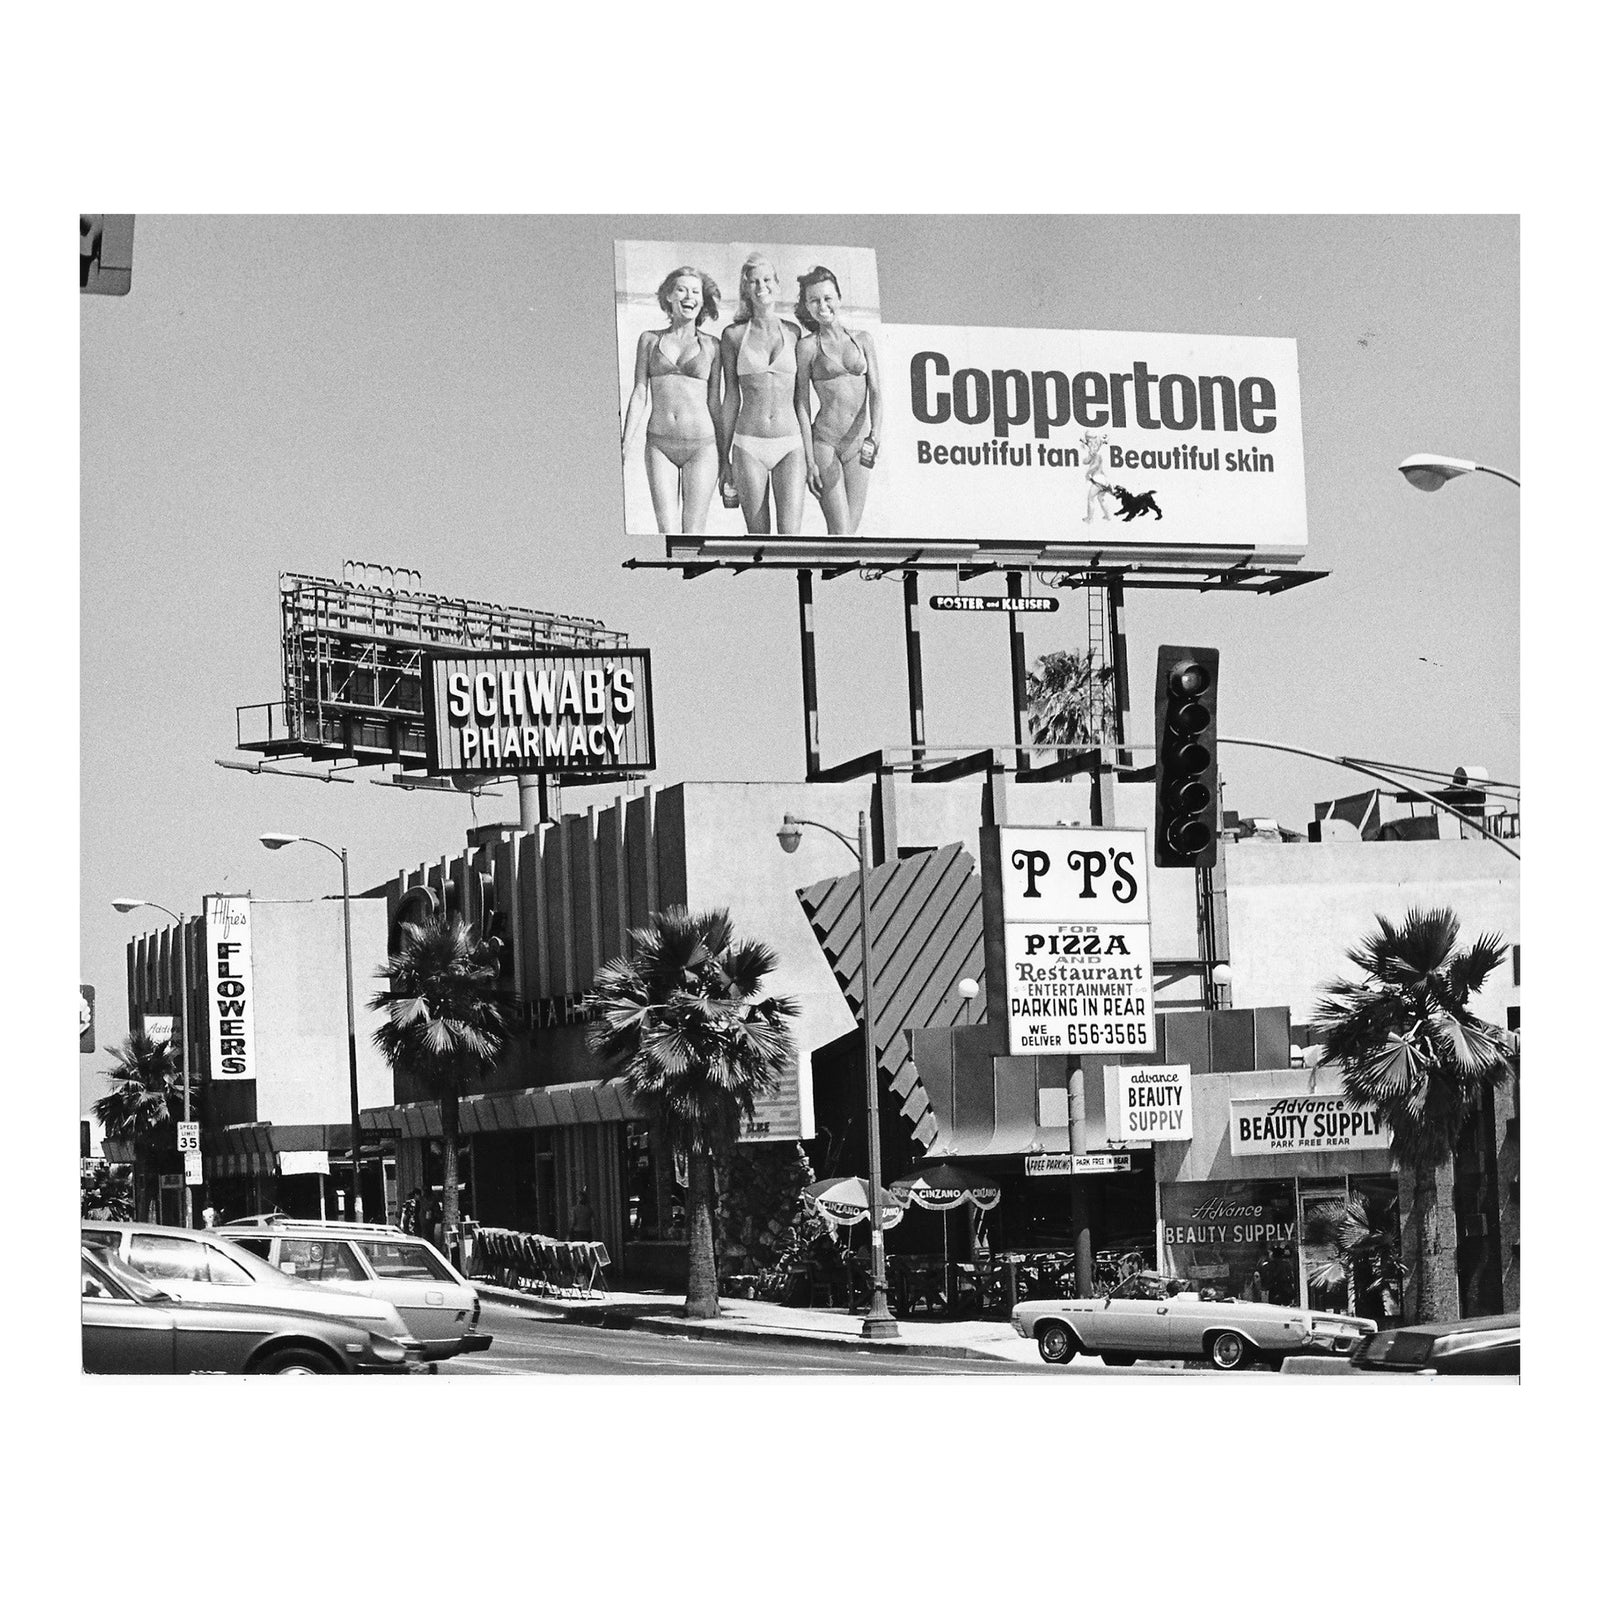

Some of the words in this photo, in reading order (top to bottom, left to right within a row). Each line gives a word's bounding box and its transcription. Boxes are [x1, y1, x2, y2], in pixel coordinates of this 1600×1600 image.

[910, 351, 1277, 439] Coppertone
[917, 440, 1032, 467] Beautiful
[1037, 443, 1079, 468] tan
[1110, 445, 1220, 471] Beautiful
[1225, 448, 1275, 473] skin
[937, 597, 985, 610] FOSTER
[1002, 598, 1051, 610] KLEISER
[449, 661, 635, 717] SCHWAB'S
[462, 725, 626, 759] PHARMACY
[1011, 849, 1051, 898] P
[1067, 847, 1138, 904] P'S
[211, 898, 247, 940] Alfie's
[1024, 935, 1131, 955] PIZZA
[1055, 956, 1102, 964] AND
[1015, 963, 1144, 982] Restaurant
[1028, 983, 1133, 997] ENTERTAINMENT
[216, 942, 248, 1075] FLOWERS
[1012, 998, 1078, 1017] PARKING
[1083, 998, 1098, 1016] IN
[1104, 998, 1145, 1016] REAR
[1021, 1035, 1062, 1047] DELIVER
[1067, 1023, 1147, 1045] 656-3565
[1029, 1024, 1047, 1035] WE
[1131, 1070, 1179, 1083] advance
[1128, 1086, 1182, 1107] BEAUTY
[1267, 1099, 1345, 1116] Advance
[1129, 1109, 1183, 1131] SUPPLY
[1239, 1115, 1308, 1141] BEAUTY
[1313, 1111, 1381, 1138] SUPPLY
[180, 1137, 197, 1148] 35
[1271, 1140, 1294, 1148] PARK
[1299, 1139, 1322, 1147] FREE
[1326, 1137, 1350, 1146] REAR
[1030, 1160, 1046, 1171] FREE
[1113, 1156, 1129, 1165] REAR
[919, 1189, 961, 1198] CINZANO
[972, 1188, 997, 1198] CINZANO
[822, 1201, 860, 1216] CINZANO
[1191, 1198, 1264, 1220] Advance
[1165, 1225, 1227, 1244] BEAUTY
[1233, 1223, 1295, 1243] SUPPLY
